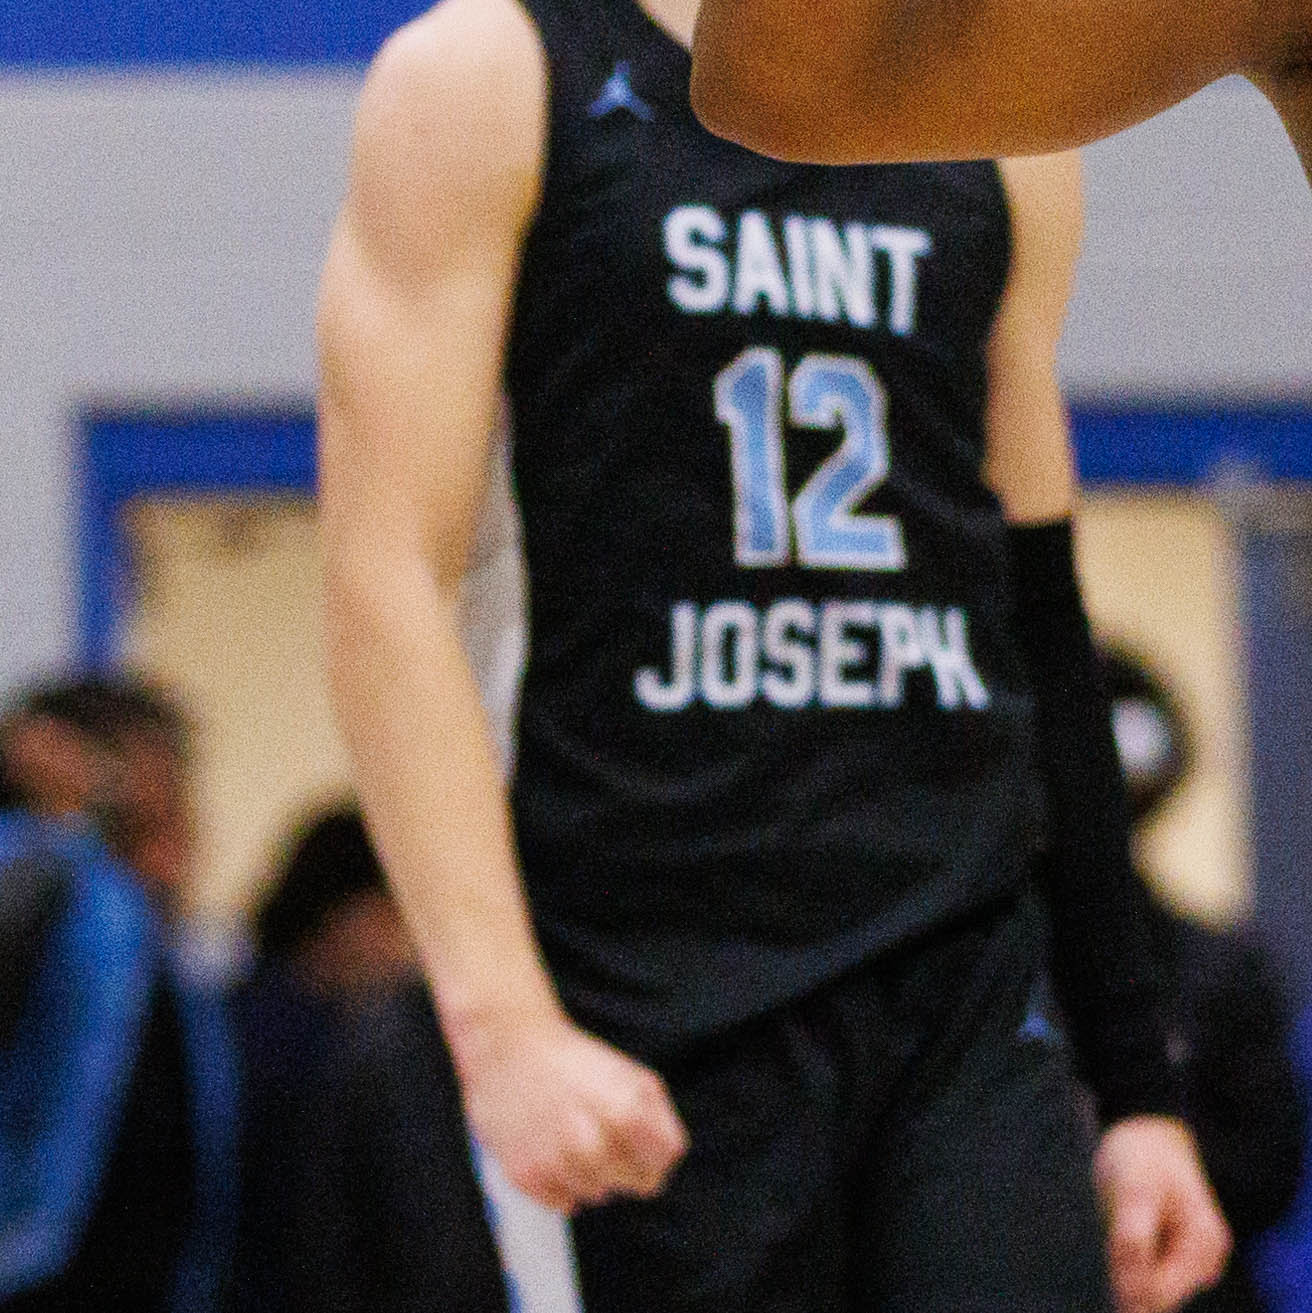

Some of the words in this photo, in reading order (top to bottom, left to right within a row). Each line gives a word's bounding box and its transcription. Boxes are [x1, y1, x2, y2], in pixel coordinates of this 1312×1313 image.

[662, 205, 932, 335] SAINT
[714, 347, 908, 571] 12
[634, 600, 989, 711] JOSEPH
